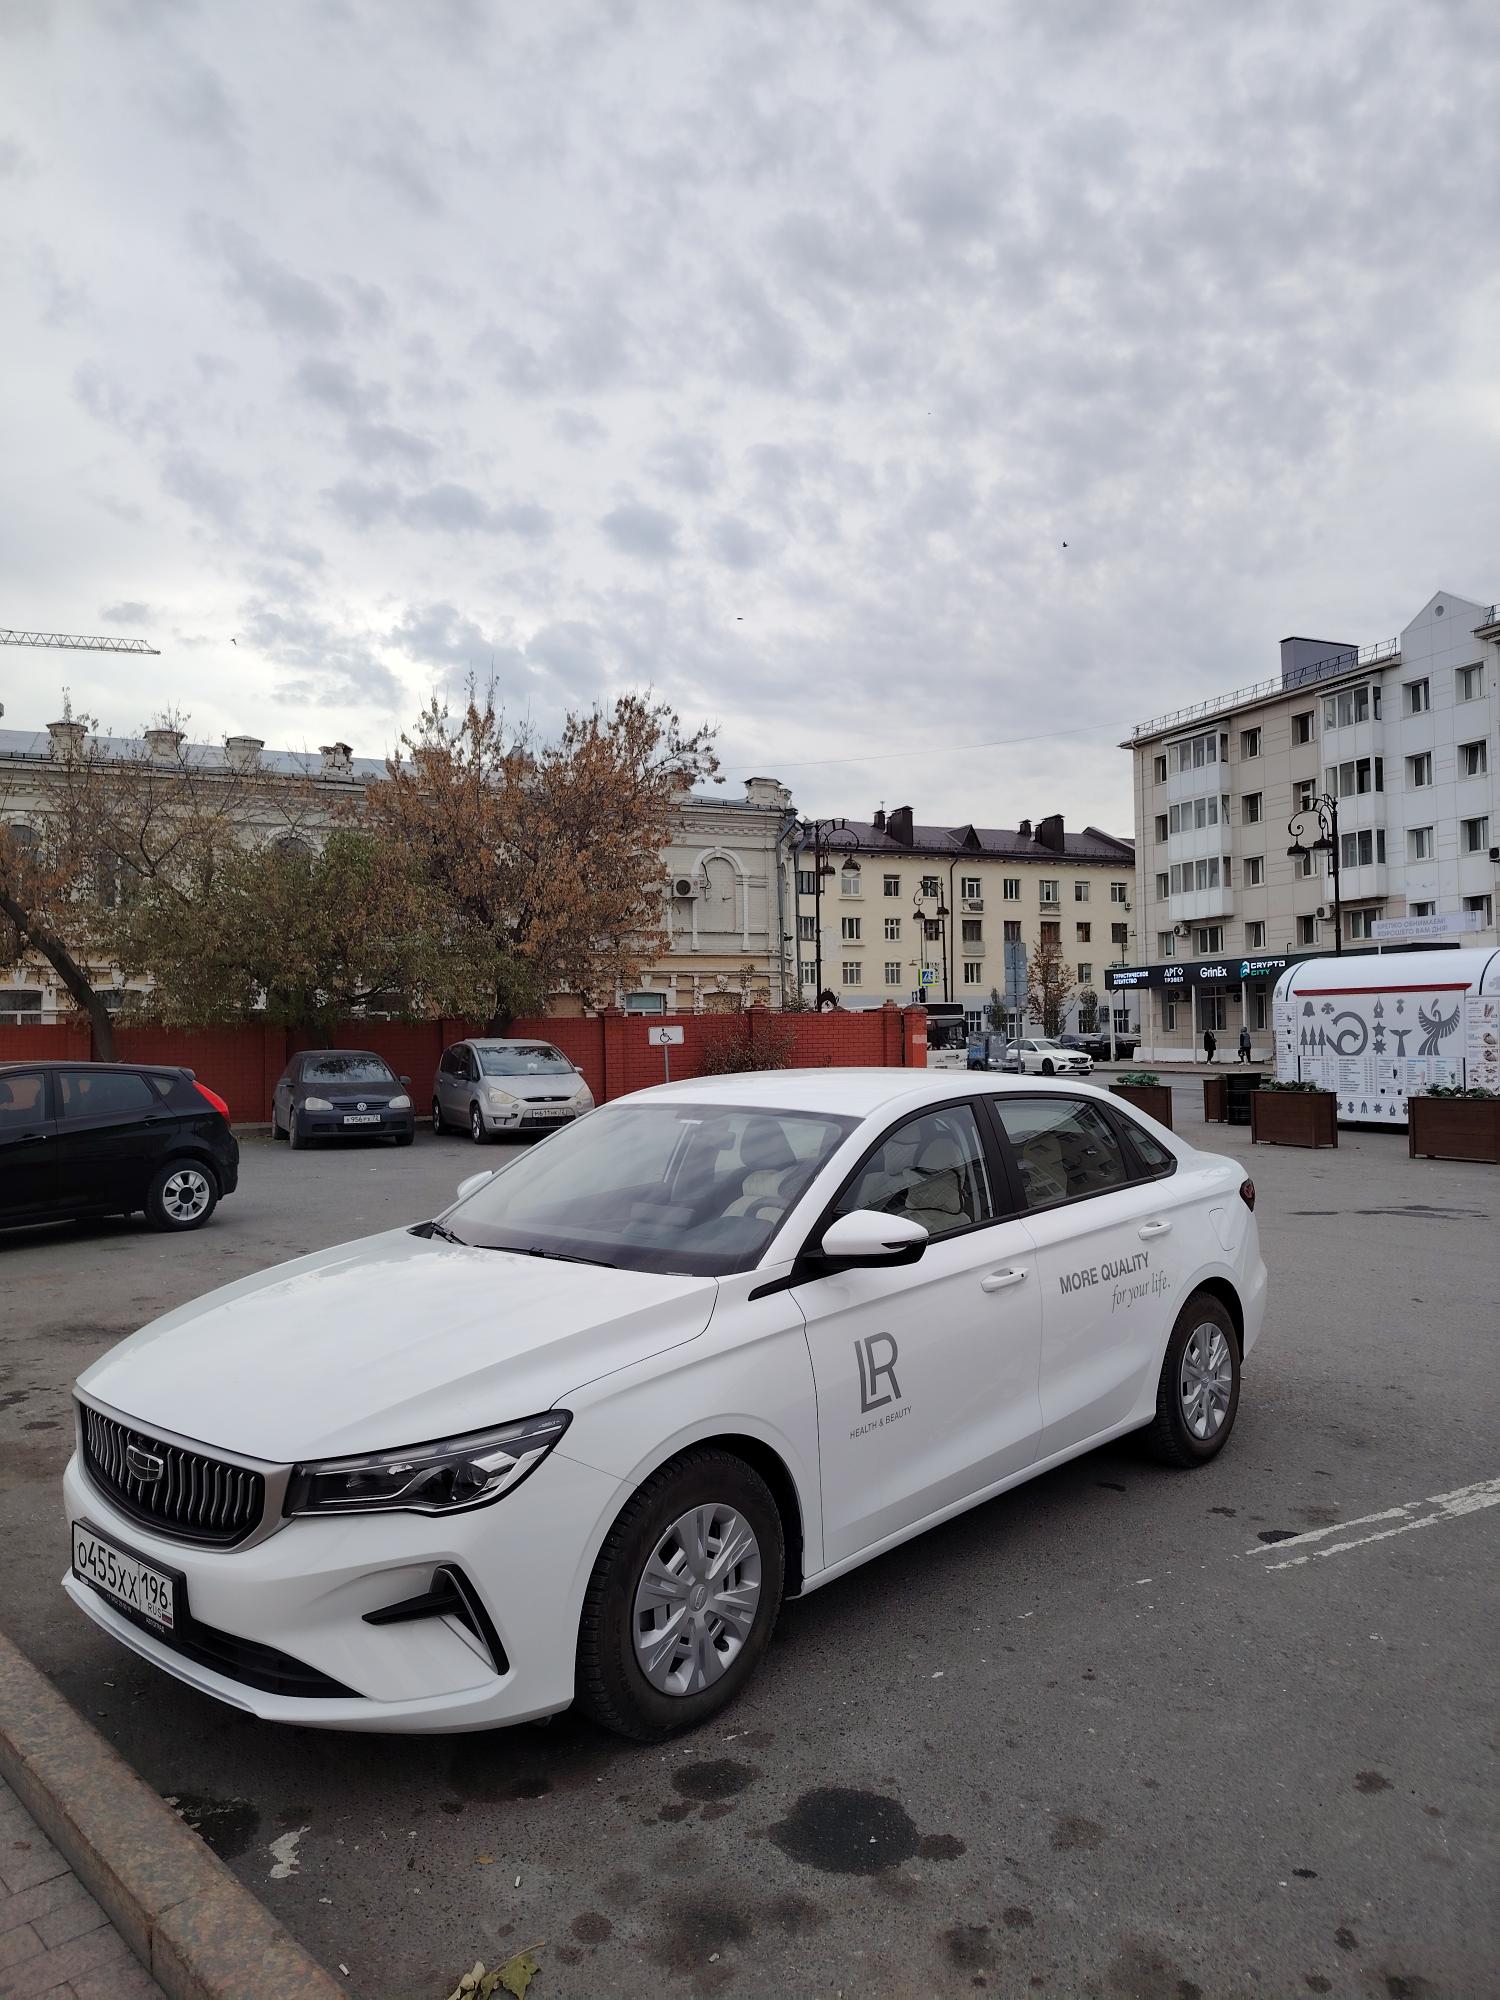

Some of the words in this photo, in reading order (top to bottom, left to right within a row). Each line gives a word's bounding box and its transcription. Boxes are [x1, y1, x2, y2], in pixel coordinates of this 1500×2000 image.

[1415, 926, 1431, 934] ВАМ
[1250, 960, 1286, 969] CRYPTO
[1113, 970, 1149, 980] ТУРИСТИЧЕСКОЕ
[1163, 967, 1184, 977] АРГО
[1199, 966, 1228, 978] GrinEx
[1250, 968, 1271, 976] CITY
[1059, 1267, 1099, 1294] MORE
[1101, 1251, 1149, 1281] QUALITY
[1112, 1284, 1127, 1314] for
[1127, 1281, 1150, 1308] your
[1151, 1270, 1171, 1298] life.
[854, 1331, 902, 1414] LR
[850, 1420, 877, 1439] HEALTH
[878, 1418, 884, 1427] &
[885, 1406, 912, 1424] BEAUTY
[141, 1571, 168, 1610] 196
[147, 1602, 162, 1618] RUS
